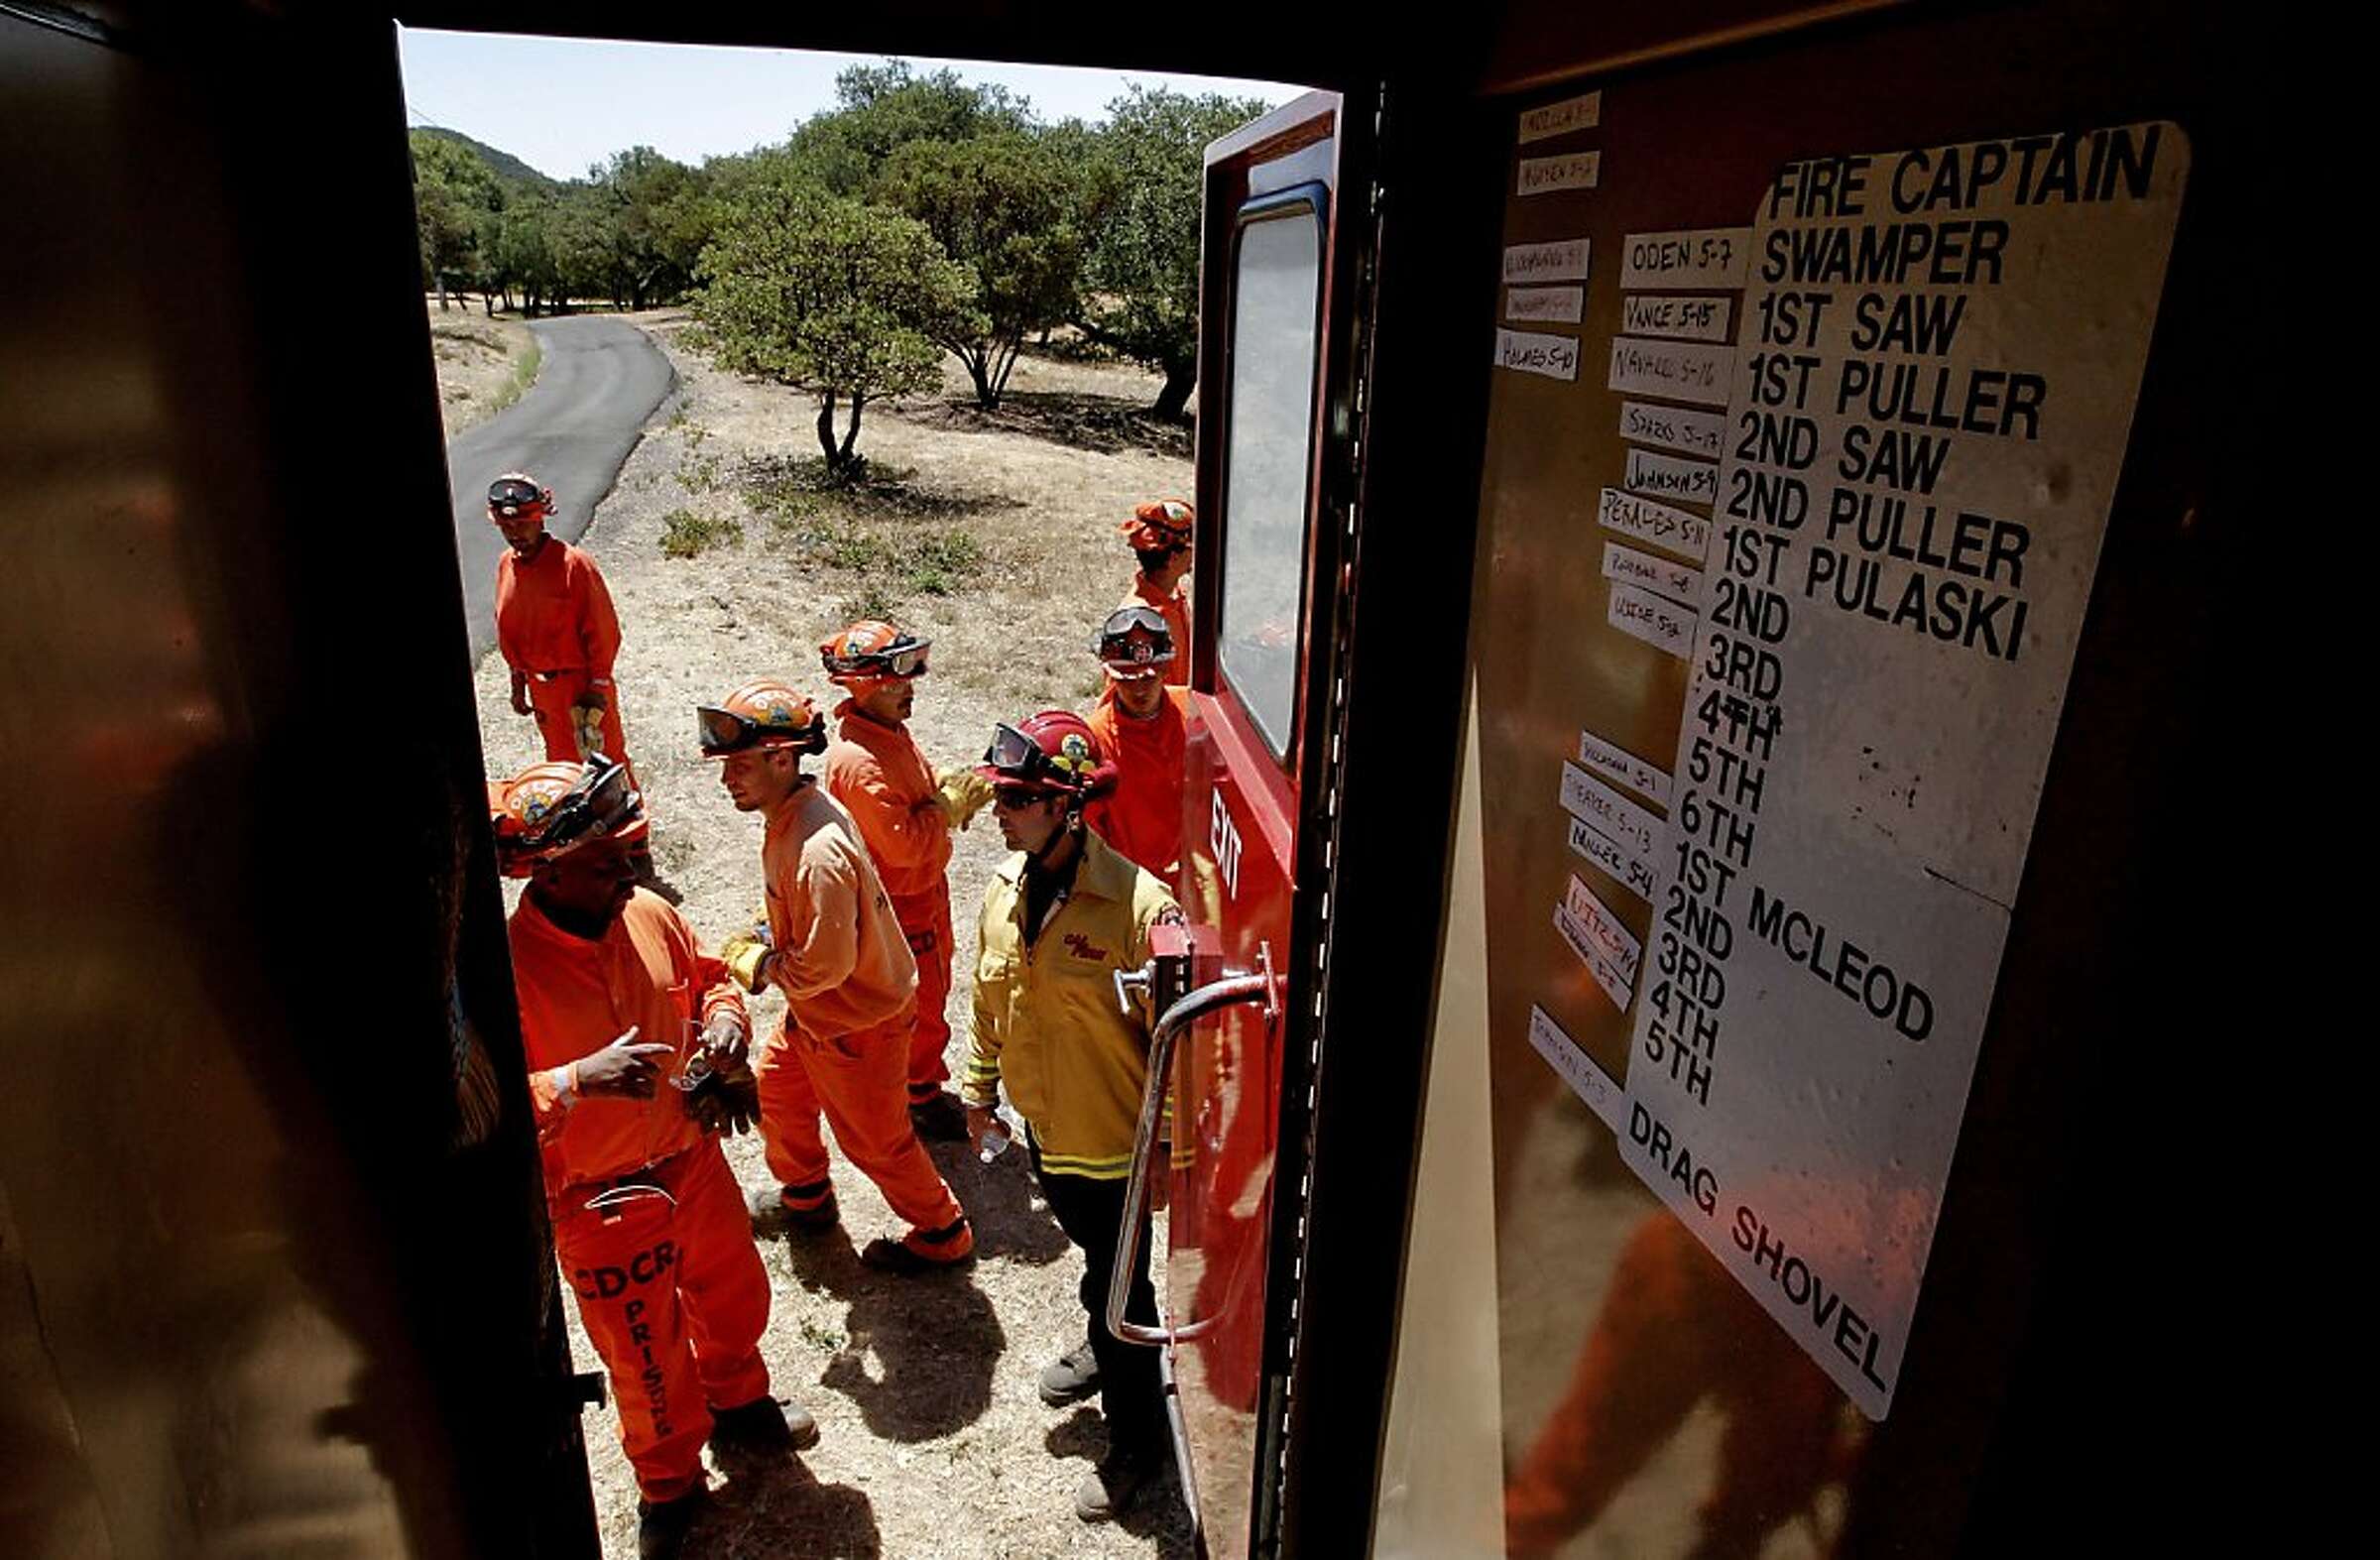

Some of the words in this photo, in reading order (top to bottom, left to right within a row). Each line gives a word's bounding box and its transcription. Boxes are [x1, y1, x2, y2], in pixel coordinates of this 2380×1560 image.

[1768, 156, 1872, 219] FIRE
[1891, 124, 2161, 214] CAPTAIN
[1632, 239, 1691, 272] ODEN
[1697, 238, 1733, 271] 5-7
[1761, 219, 2009, 285] SWAMPER
[1626, 297, 1674, 328] VANCE
[1677, 303, 1717, 328] 5-15
[1759, 292, 1833, 348] 1ST
[1850, 293, 1967, 357] SAW
[1748, 352, 1821, 411] 1ST
[1836, 358, 2047, 440] PULLER
[1735, 411, 1819, 471] 2ND
[1838, 424, 1951, 495] SAW
[1602, 490, 1676, 537] PERALES
[1727, 468, 1809, 532] 2ND
[1827, 487, 2031, 588] PULLER
[1711, 577, 1790, 645] 2ND
[1724, 524, 1790, 587] 1ST
[1805, 546, 2029, 663] PULASKI
[1705, 633, 1782, 703] 3RD
[1698, 690, 1778, 762] 4TH
[1688, 737, 1766, 814] 5TH
[1211, 785, 1243, 901] EXIT
[1681, 789, 1754, 869] 6TH
[1664, 885, 1734, 962] 2ND
[1676, 840, 1736, 906] 1ST
[1747, 886, 1934, 1043] MCLEOD
[1658, 931, 1726, 1012] 3RD
[1650, 980, 1720, 1061] 4TH
[1645, 1020, 1713, 1107] 5TH
[575, 1240, 676, 1300] CDCR
[1628, 1100, 1720, 1219] DRAG
[1731, 1205, 1887, 1394] SHOVEL
